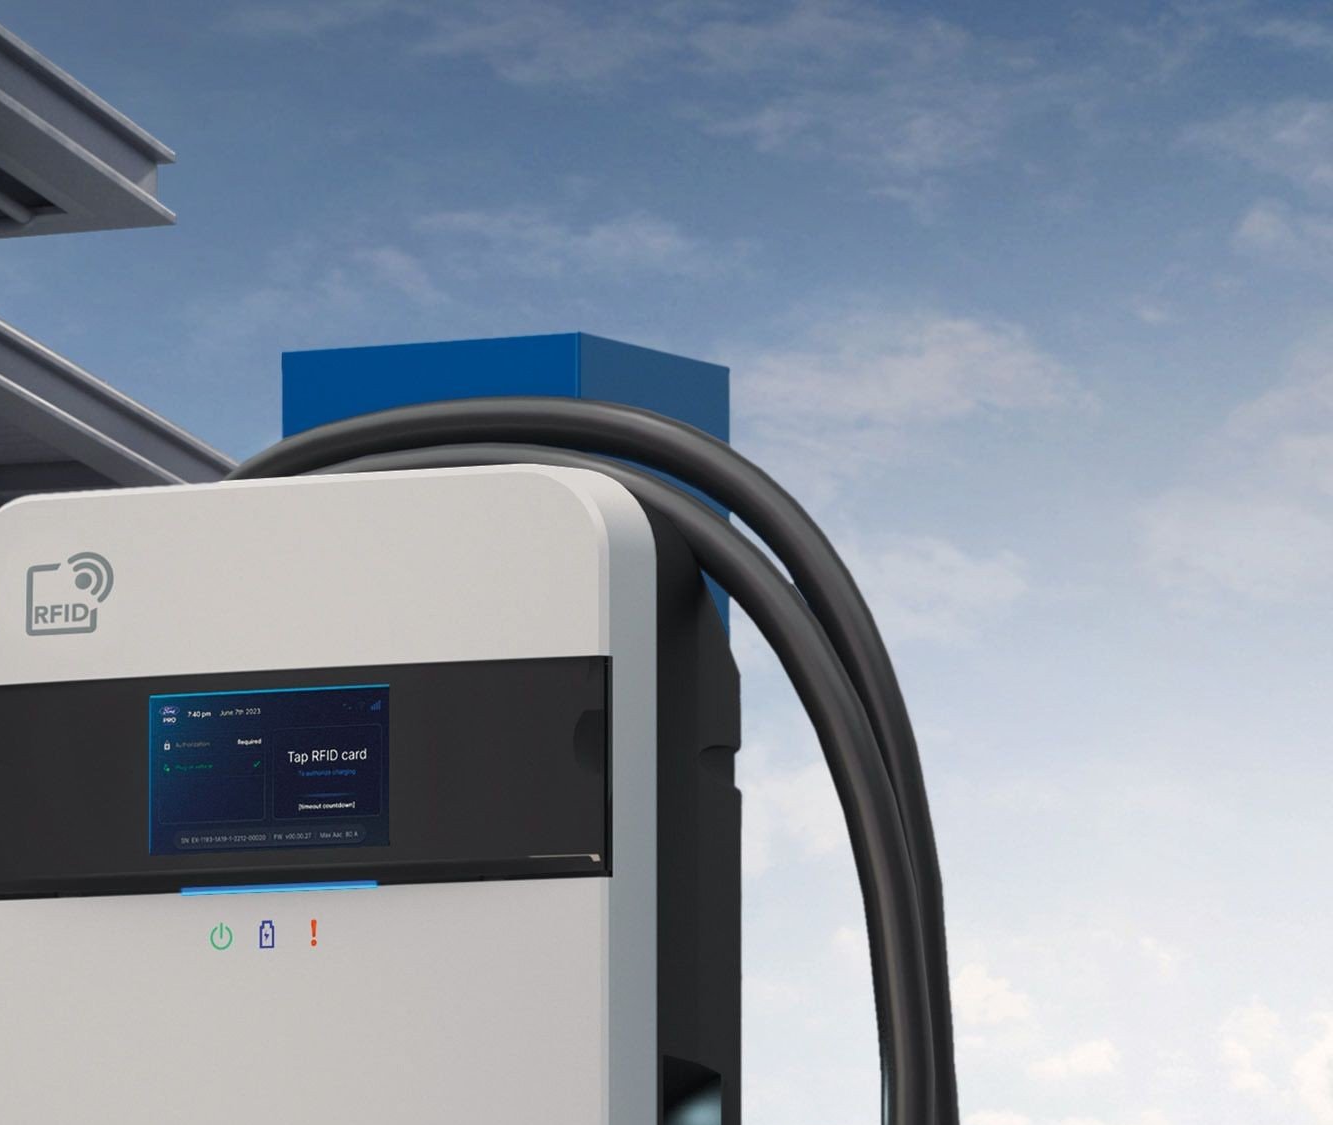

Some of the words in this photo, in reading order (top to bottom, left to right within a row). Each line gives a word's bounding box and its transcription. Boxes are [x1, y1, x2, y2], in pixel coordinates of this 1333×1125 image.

[34, 603, 89, 624] RFID
[237, 738, 262, 747] Required
[287, 751, 309, 765] Tap
[311, 749, 338, 762] RFID
[341, 748, 367, 761] card
